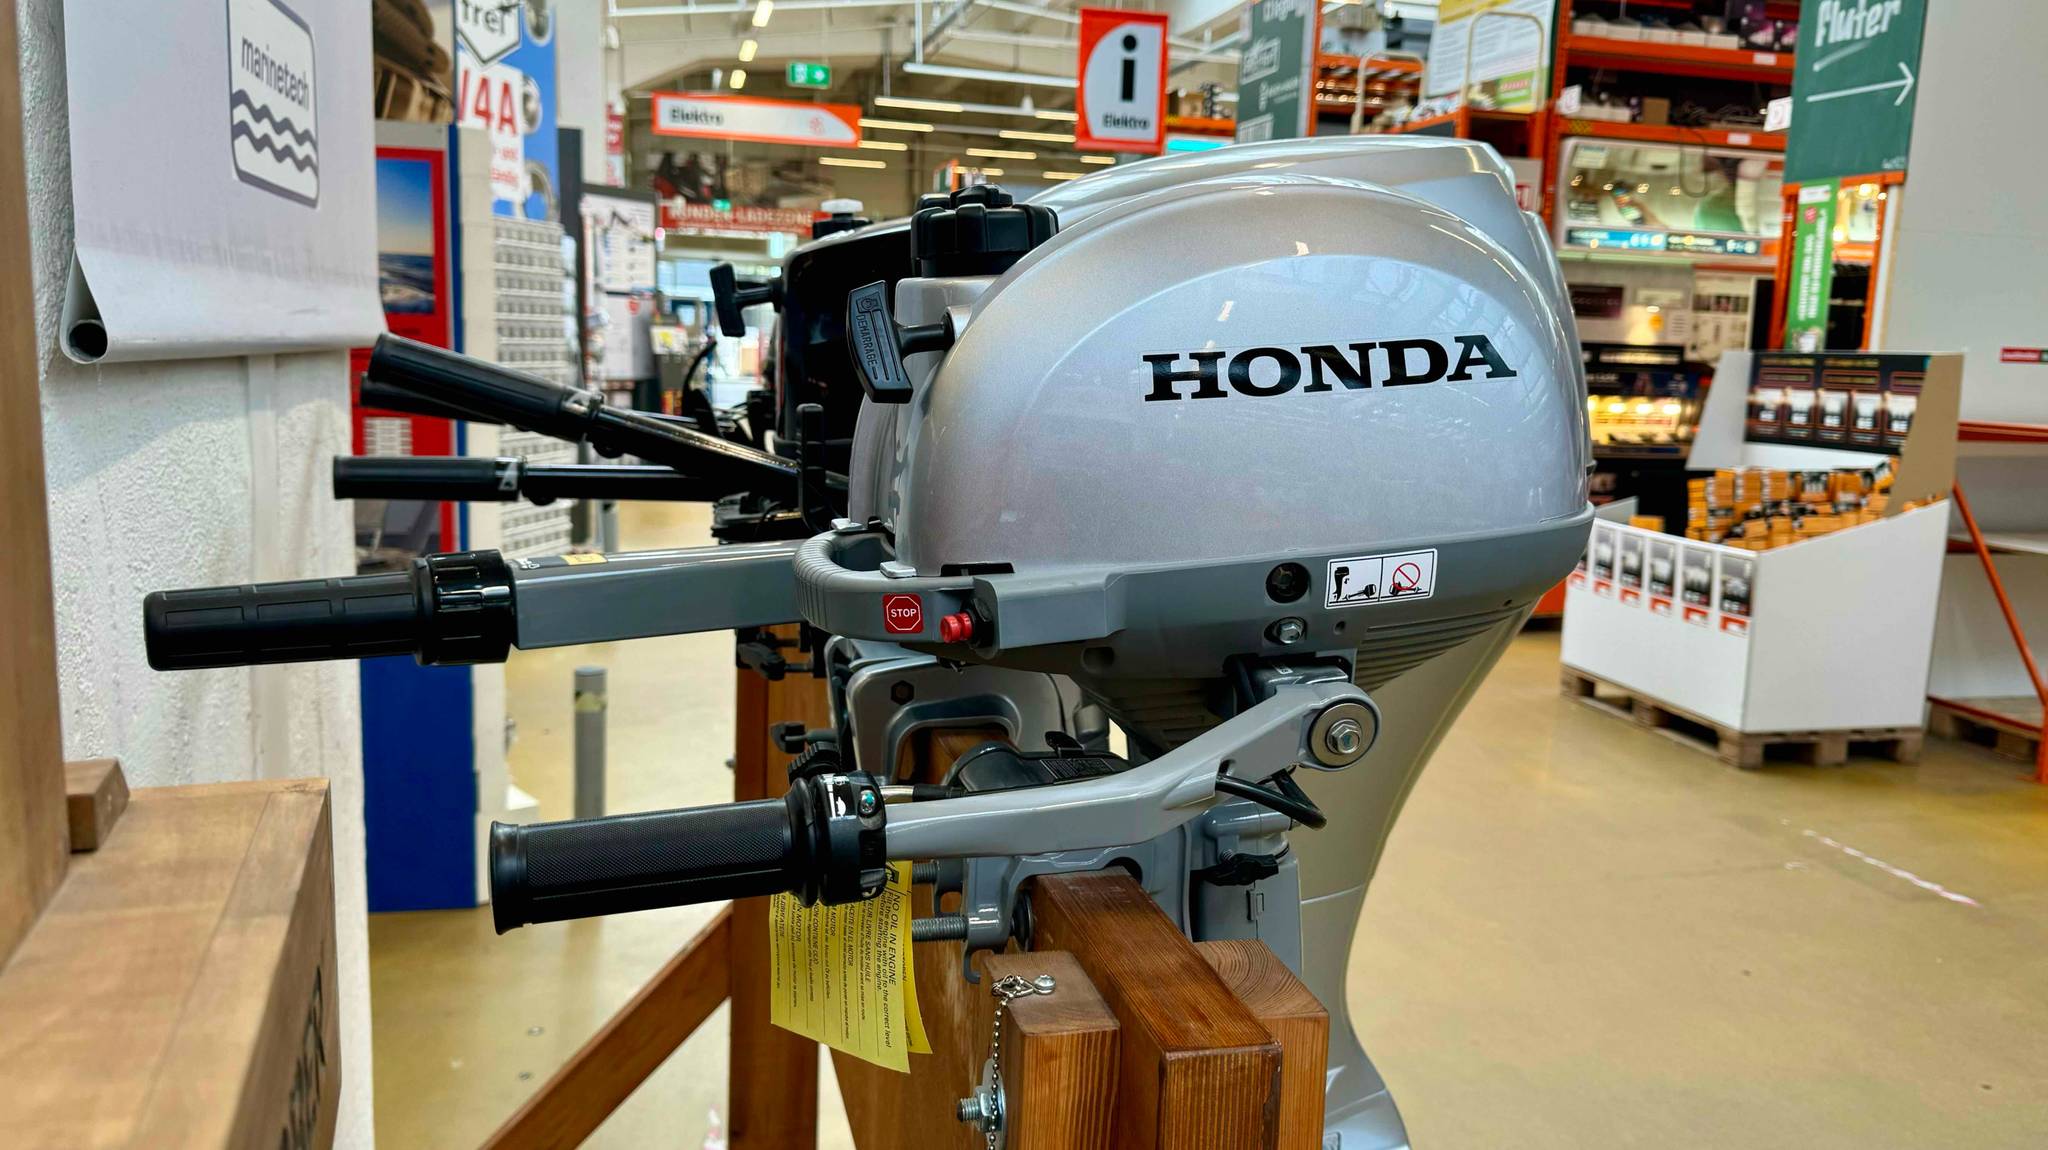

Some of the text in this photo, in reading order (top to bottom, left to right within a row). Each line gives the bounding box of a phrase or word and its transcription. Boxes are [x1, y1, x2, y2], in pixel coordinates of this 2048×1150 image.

[1815, 0, 1902, 47] Fluter
[242, 36, 309, 111] marinetech
[669, 108, 723, 126] Elektro
[1103, 113, 1149, 130] Elektro
[1142, 333, 1518, 402] HONDA
[890, 608, 917, 618] STOP
[876, 918, 884, 948] starting
[881, 920, 889, 948] engine
[888, 895, 901, 986] NO OIL IN ENGINE
